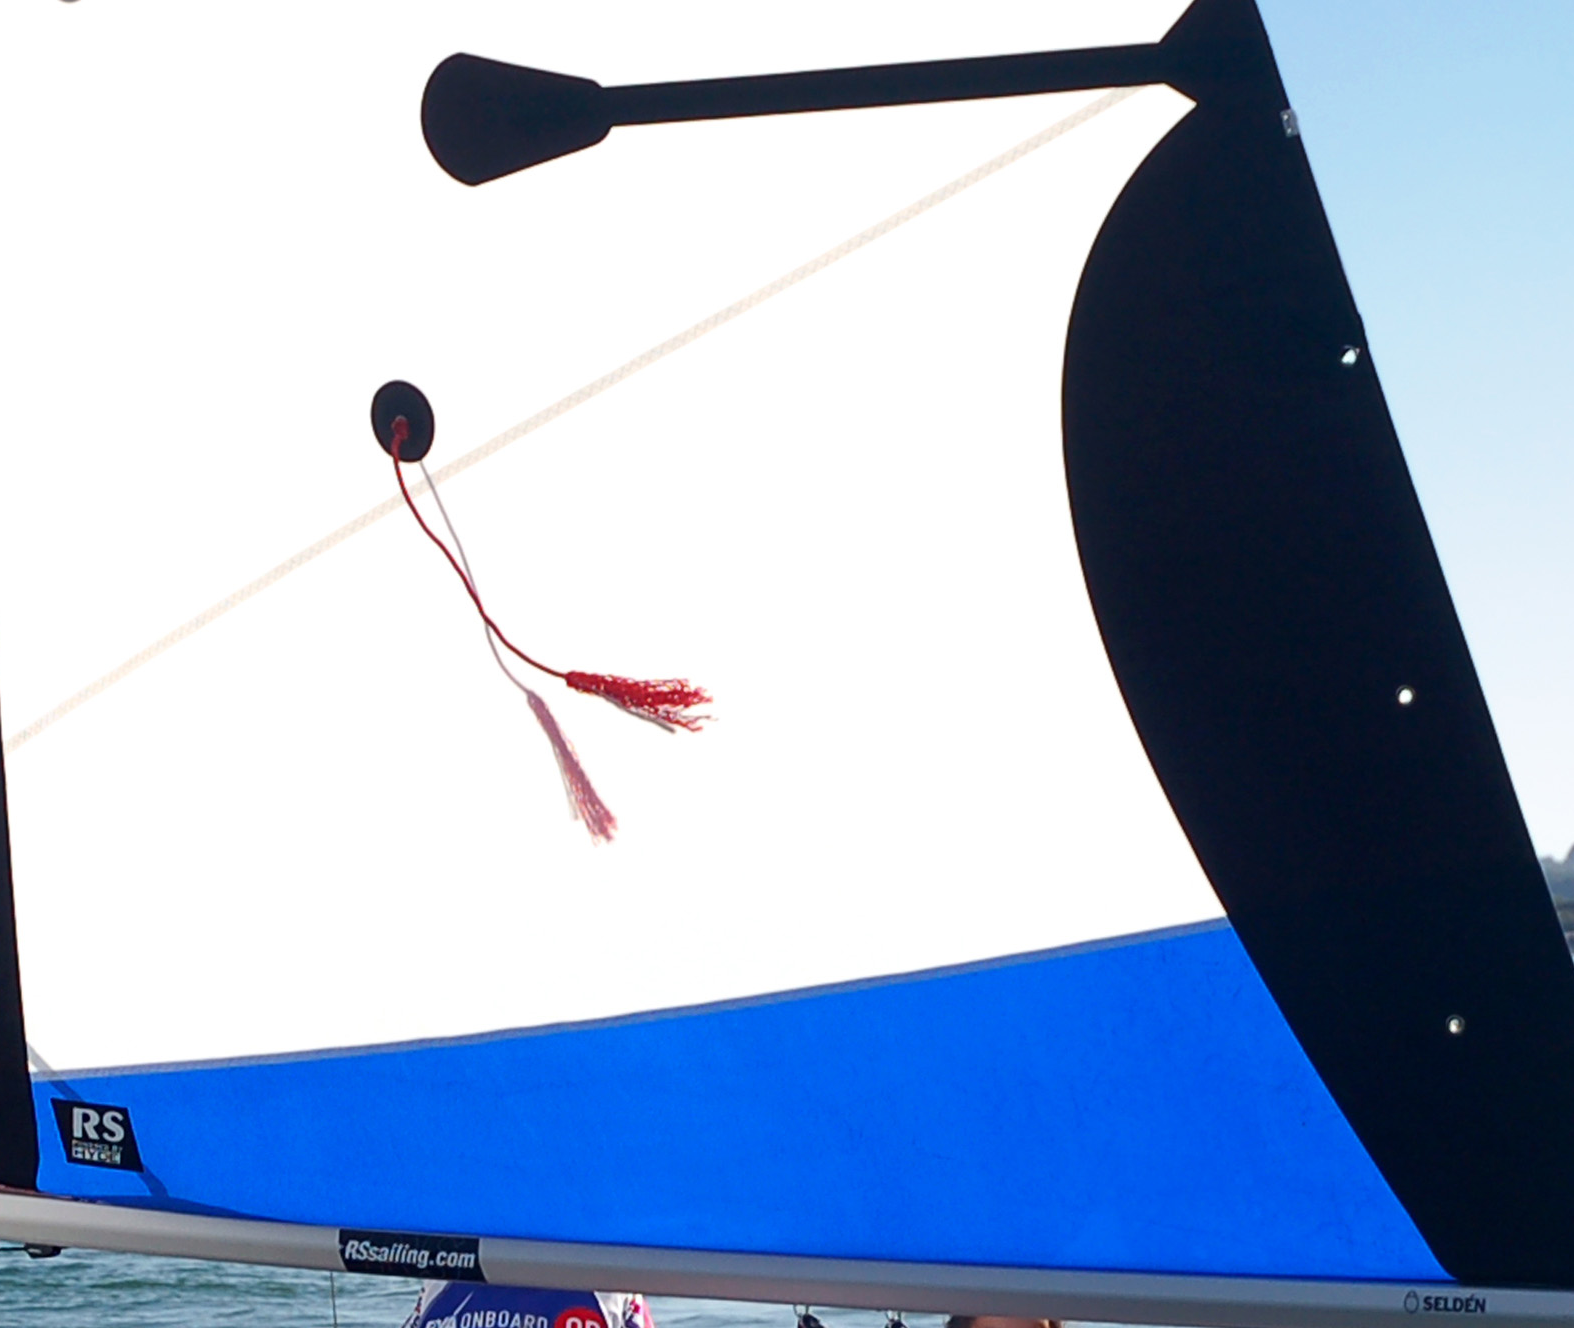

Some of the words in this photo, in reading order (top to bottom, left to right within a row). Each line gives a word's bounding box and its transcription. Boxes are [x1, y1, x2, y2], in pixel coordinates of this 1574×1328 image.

[72, 1107, 125, 1143] RS
[344, 1240, 476, 1268] RSsailing.com
[1423, 1293, 1487, 1313] SELDÉN
